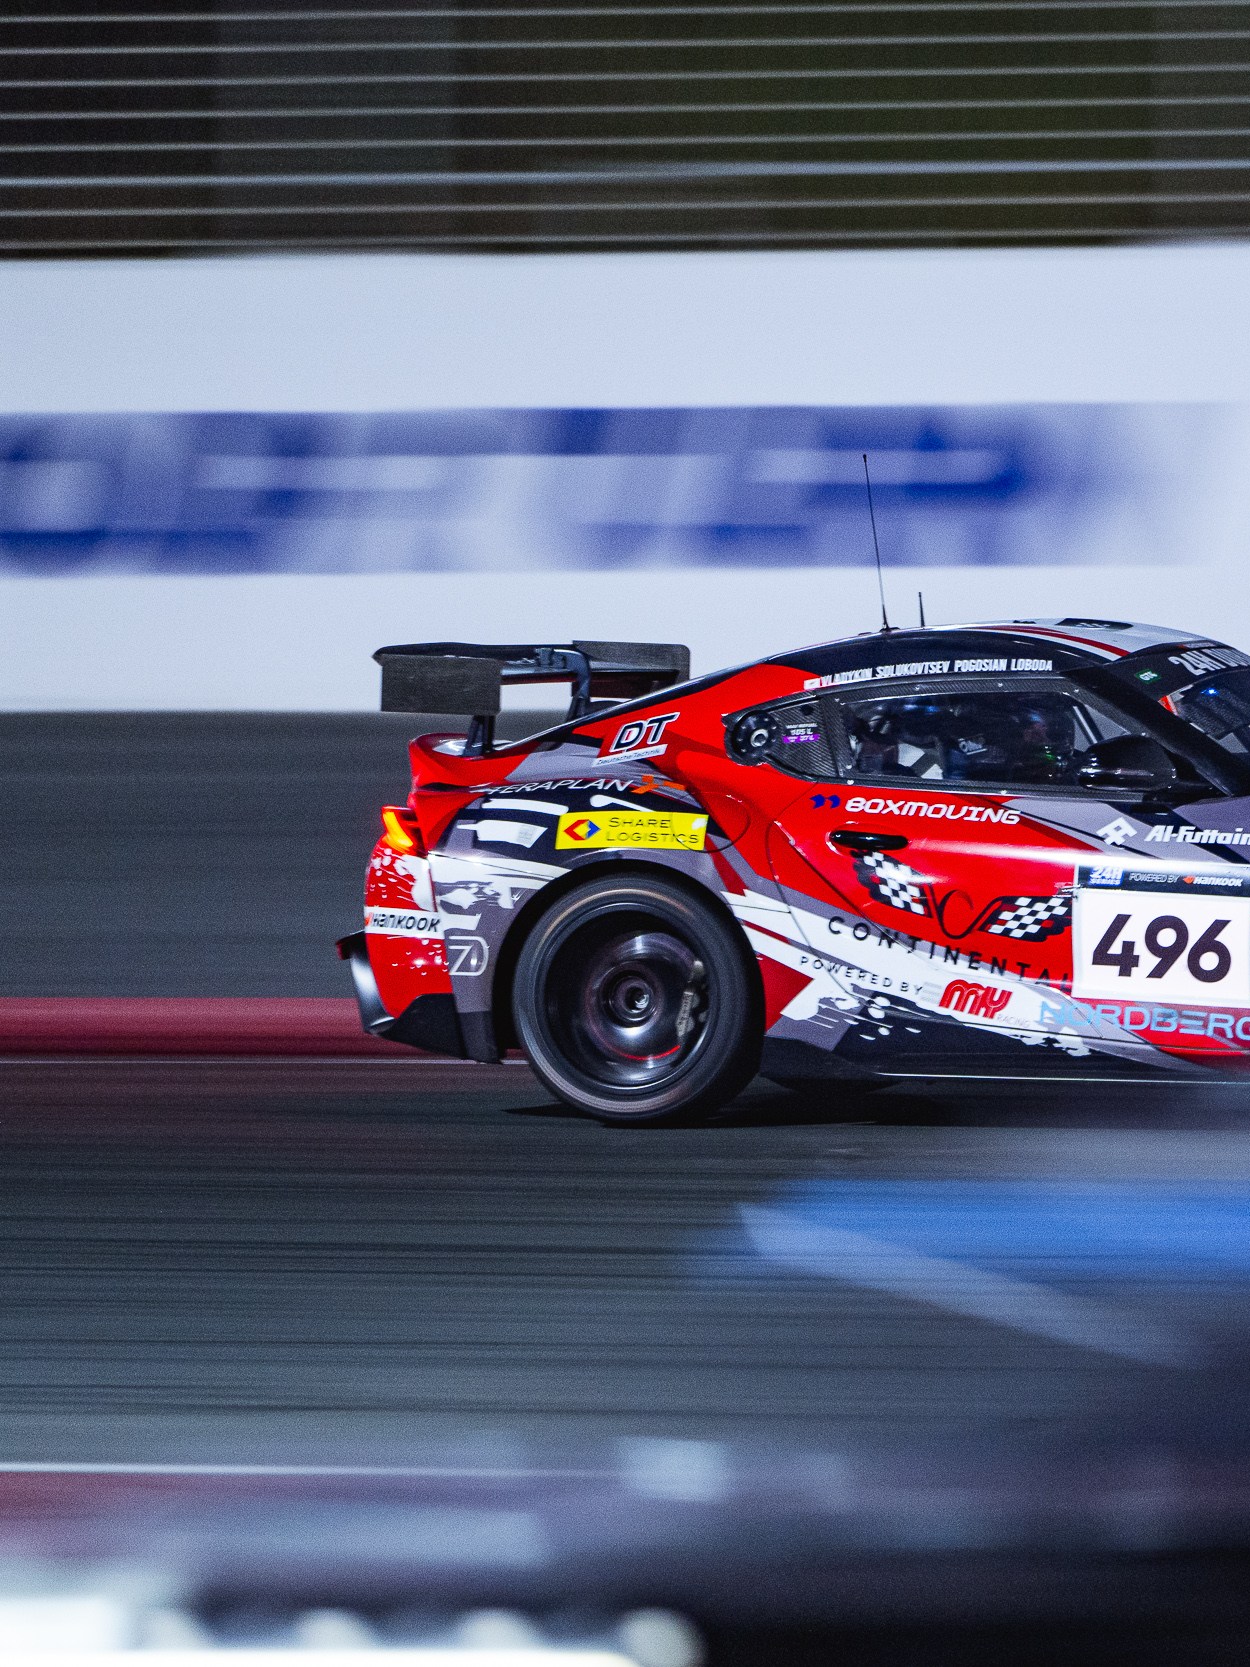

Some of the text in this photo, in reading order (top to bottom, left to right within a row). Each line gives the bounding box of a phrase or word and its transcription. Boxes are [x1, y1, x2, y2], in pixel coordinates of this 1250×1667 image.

[875, 661, 950, 678] SOLUKOVTSEV
[954, 659, 1007, 672] POGOSIAN
[1010, 659, 1053, 671] LOBODA
[1168, 651, 1227, 676] 24H
[609, 712, 680, 752] DT
[608, 817, 671, 829] SHARE
[845, 797, 1021, 825] BOXMOVING
[606, 831, 699, 844] LOGISTICS
[1091, 866, 1123, 879] 24H
[1129, 872, 1180, 884] POWERED BY
[828, 916, 1072, 993] CONTINENTAL
[1091, 913, 1232, 983] 496
[800, 955, 923, 996] POWERED BY
